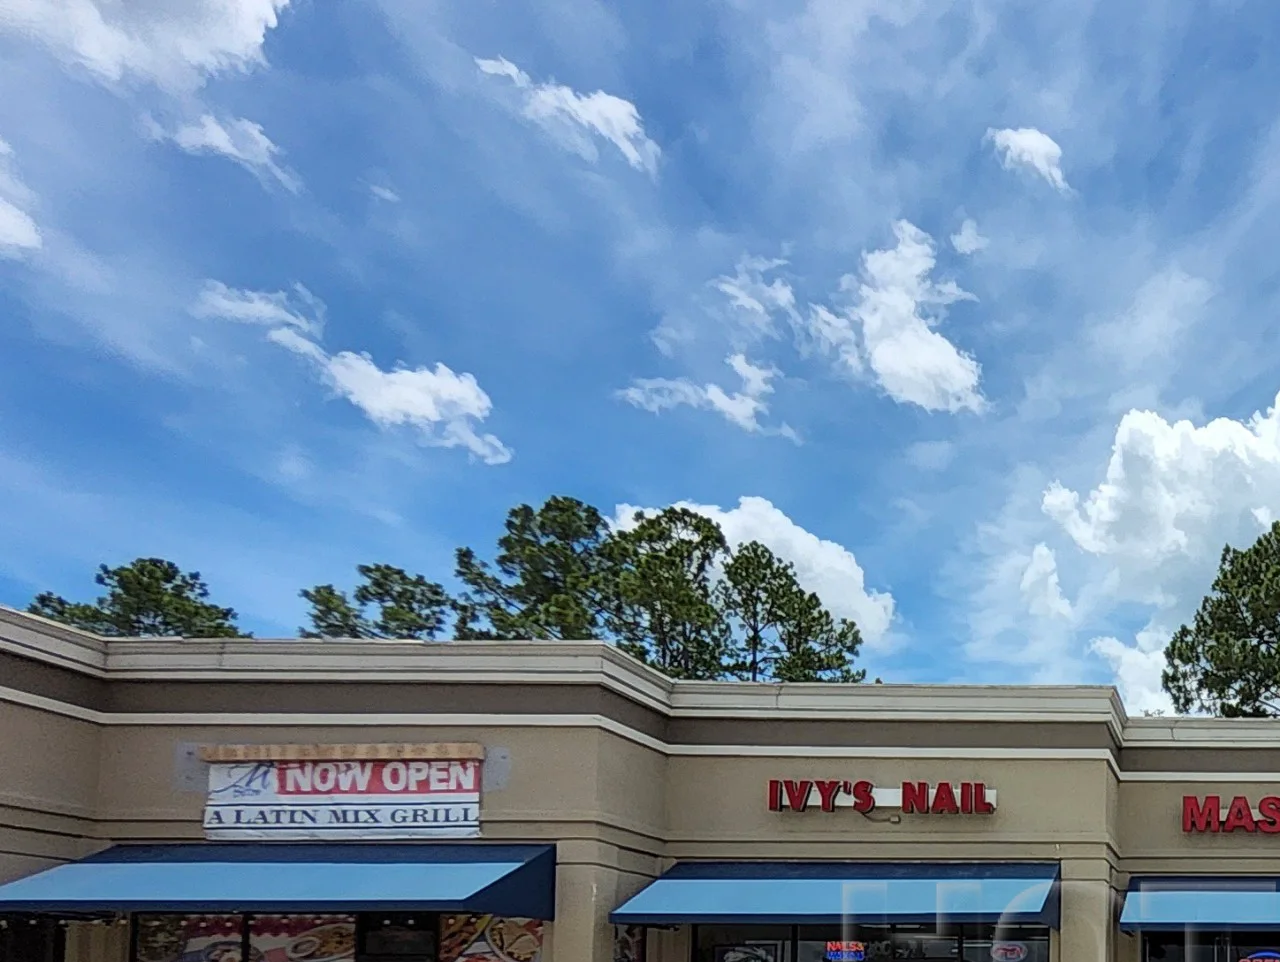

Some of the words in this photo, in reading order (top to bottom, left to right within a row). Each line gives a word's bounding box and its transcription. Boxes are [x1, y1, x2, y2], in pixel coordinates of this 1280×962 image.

[285, 761, 372, 792] NOW
[382, 760, 475, 791] OPEN
[768, 780, 876, 814] IVY'S
[901, 781, 996, 814] NAIL
[207, 810, 224, 825] A
[233, 809, 319, 824] LATIN
[328, 809, 384, 824] MIX
[390, 808, 480, 824] GRILL
